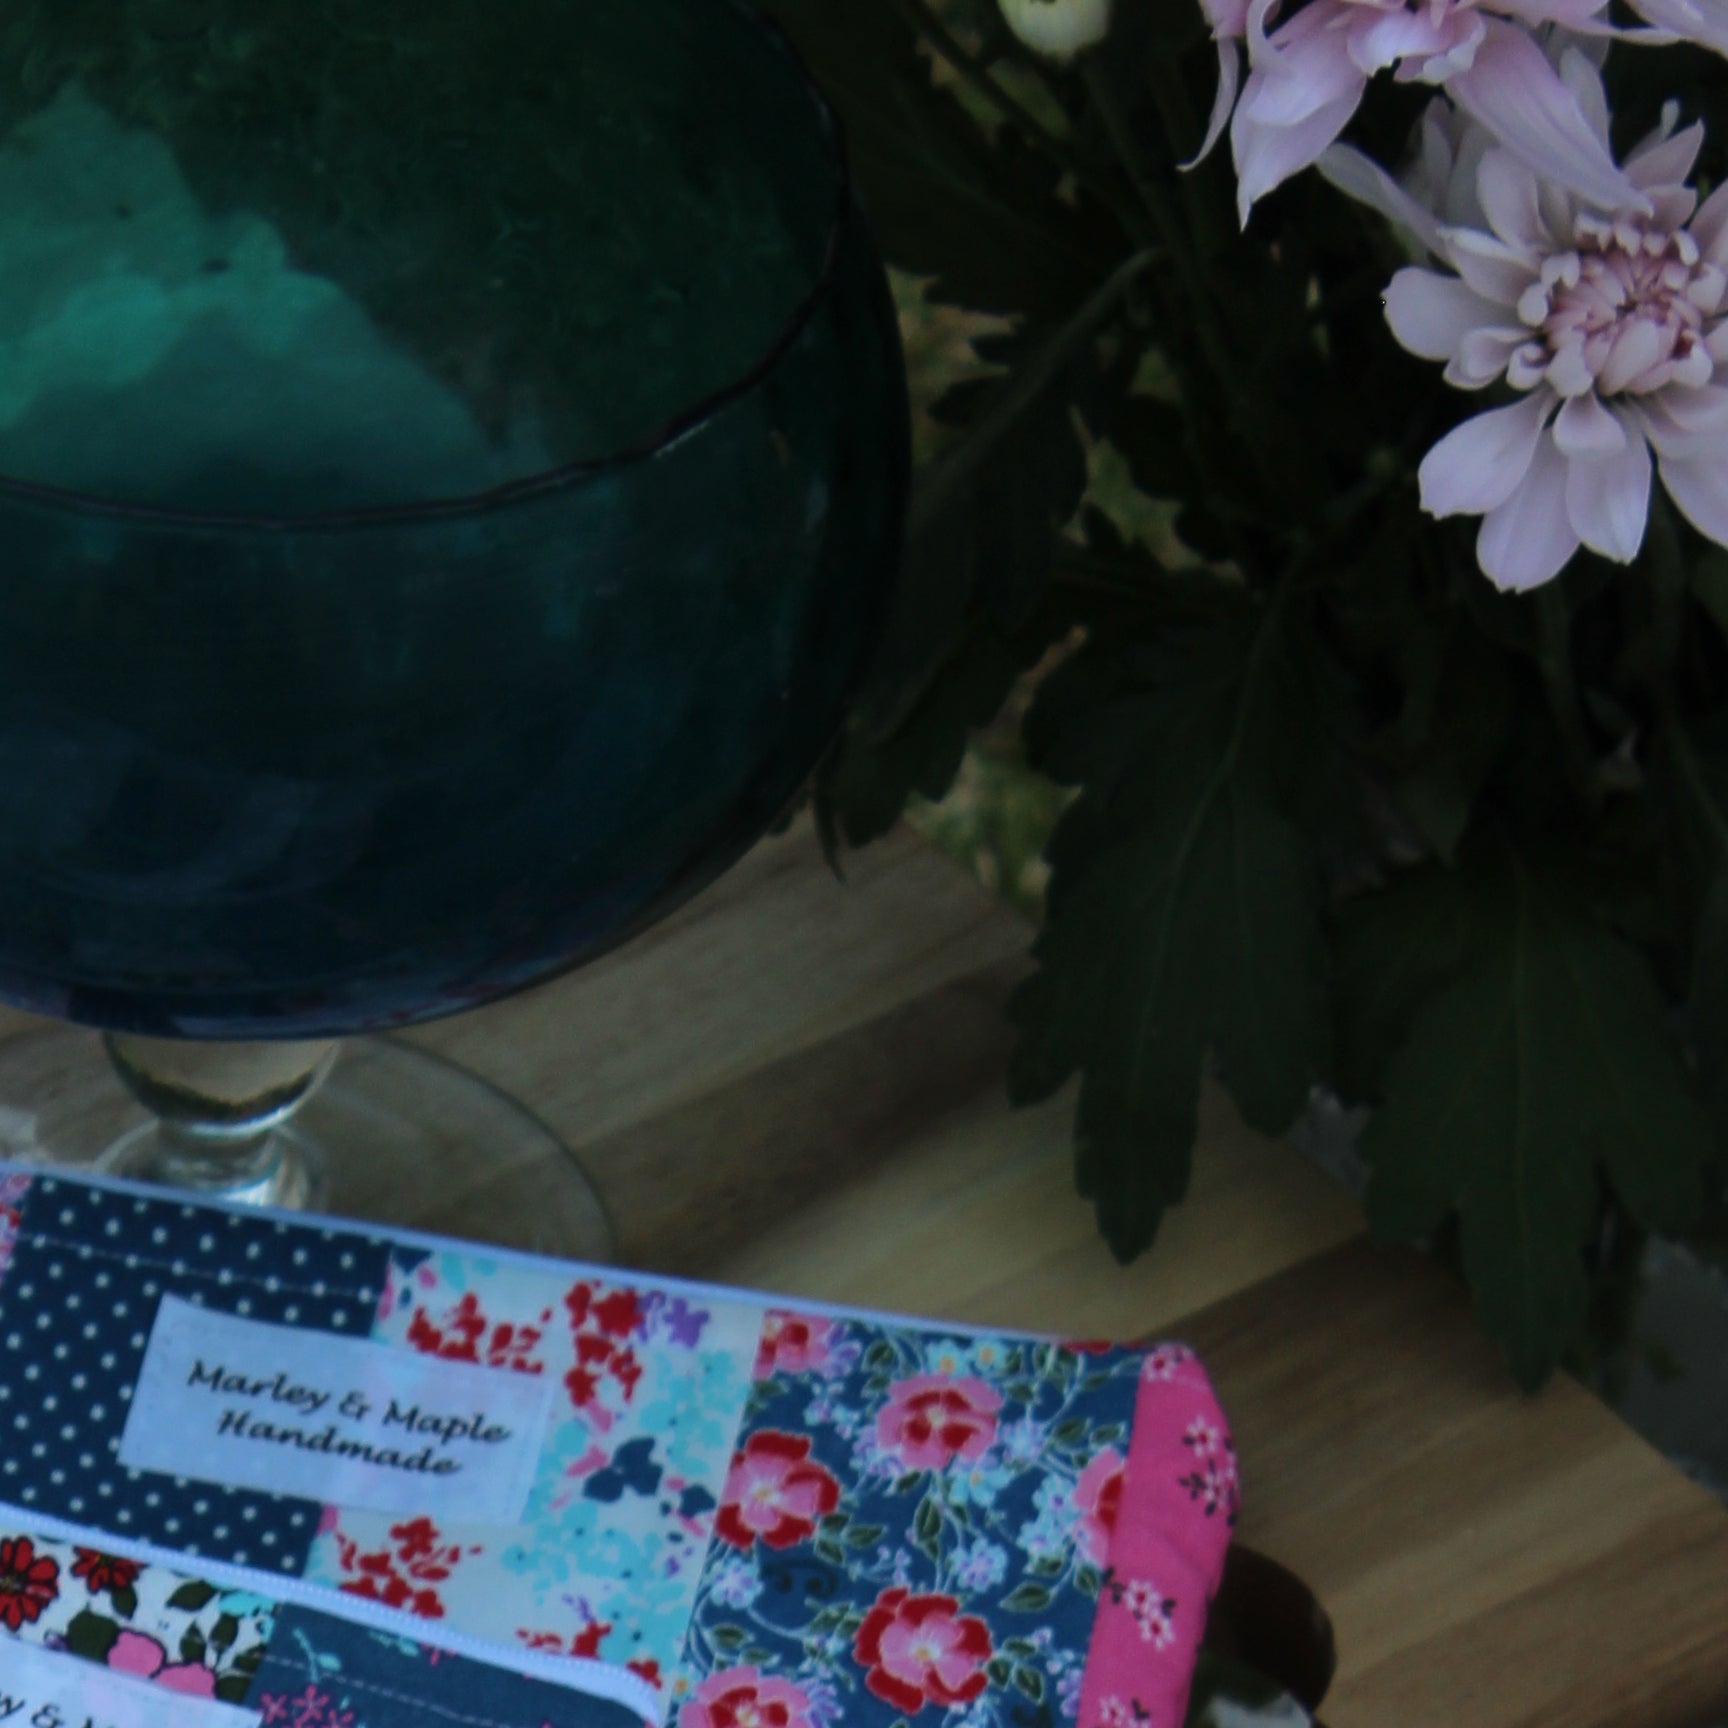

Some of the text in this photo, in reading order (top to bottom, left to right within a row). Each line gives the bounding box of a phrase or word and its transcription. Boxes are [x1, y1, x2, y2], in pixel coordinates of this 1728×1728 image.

[187, 1359, 512, 1444] Marley & Maple
[216, 1408, 462, 1476] Handmade
